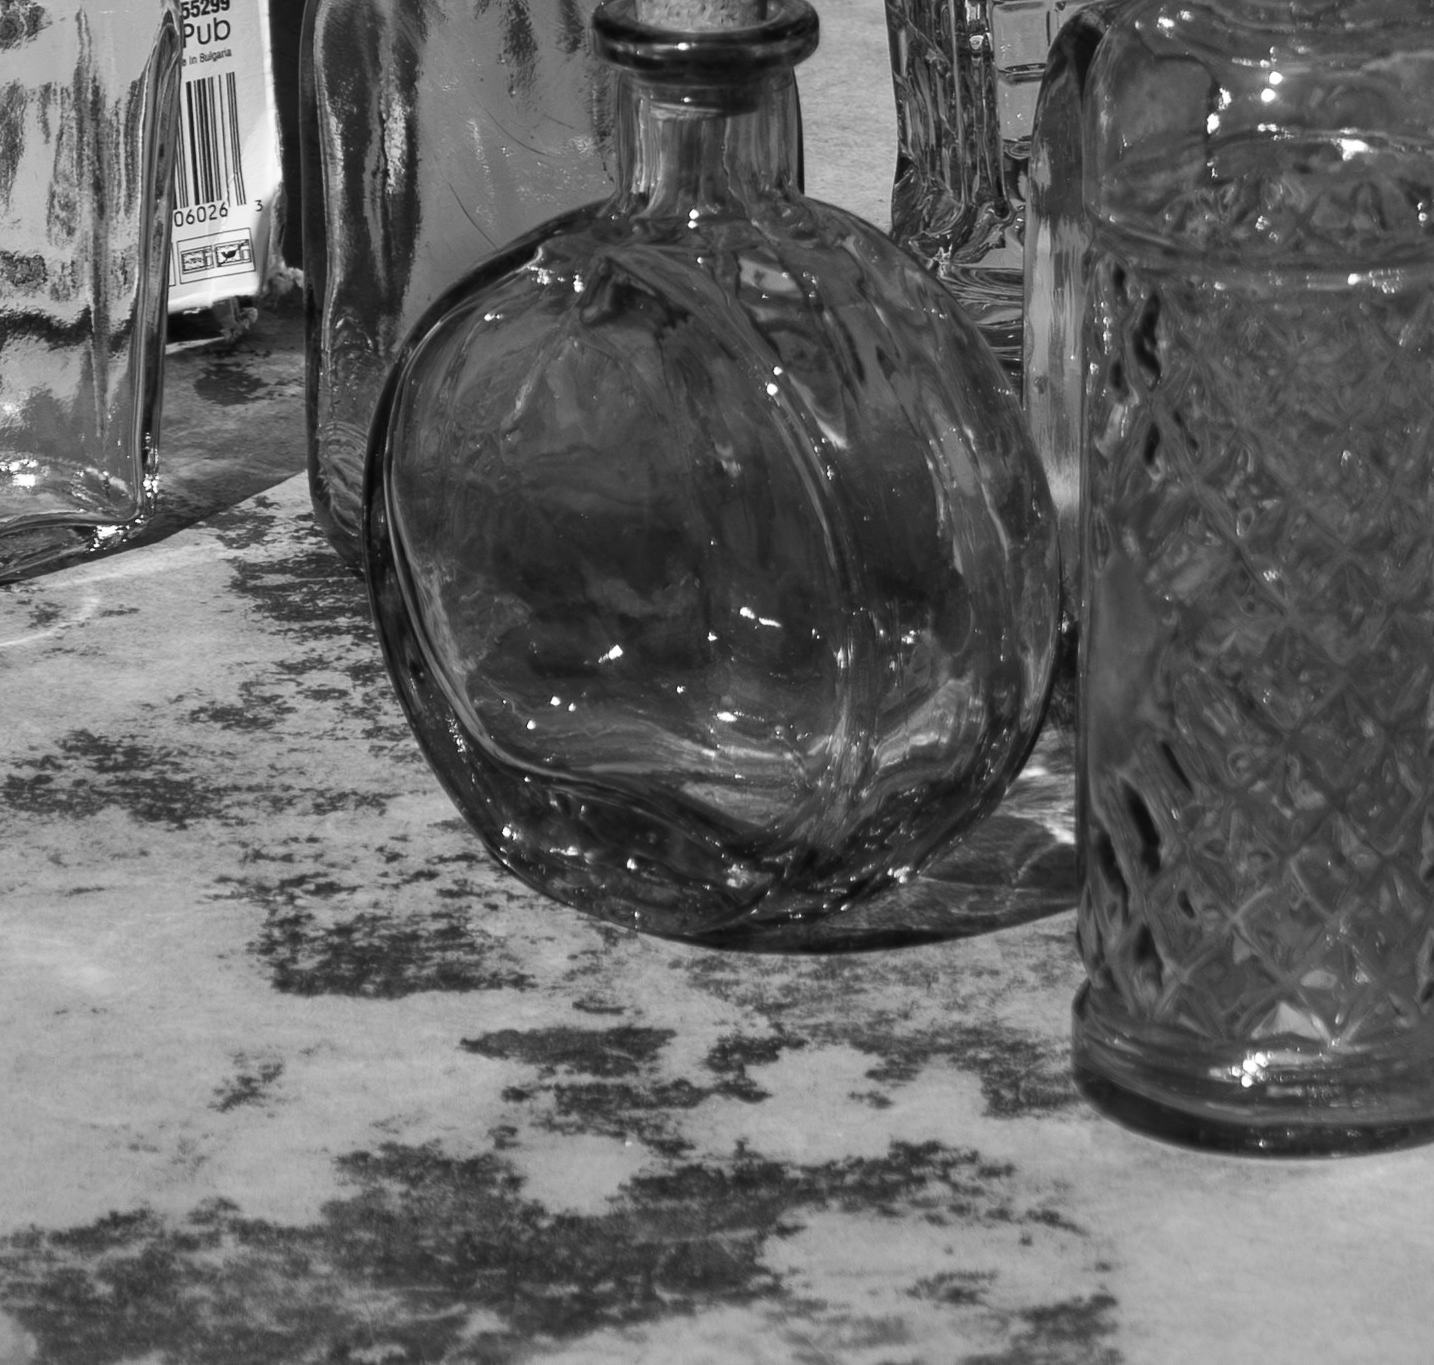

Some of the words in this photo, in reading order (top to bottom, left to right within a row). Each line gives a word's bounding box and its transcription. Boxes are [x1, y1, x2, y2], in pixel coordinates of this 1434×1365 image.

[183, 17, 231, 49] Pub
[173, 202, 229, 228] 06026
[254, 199, 264, 212] 3
